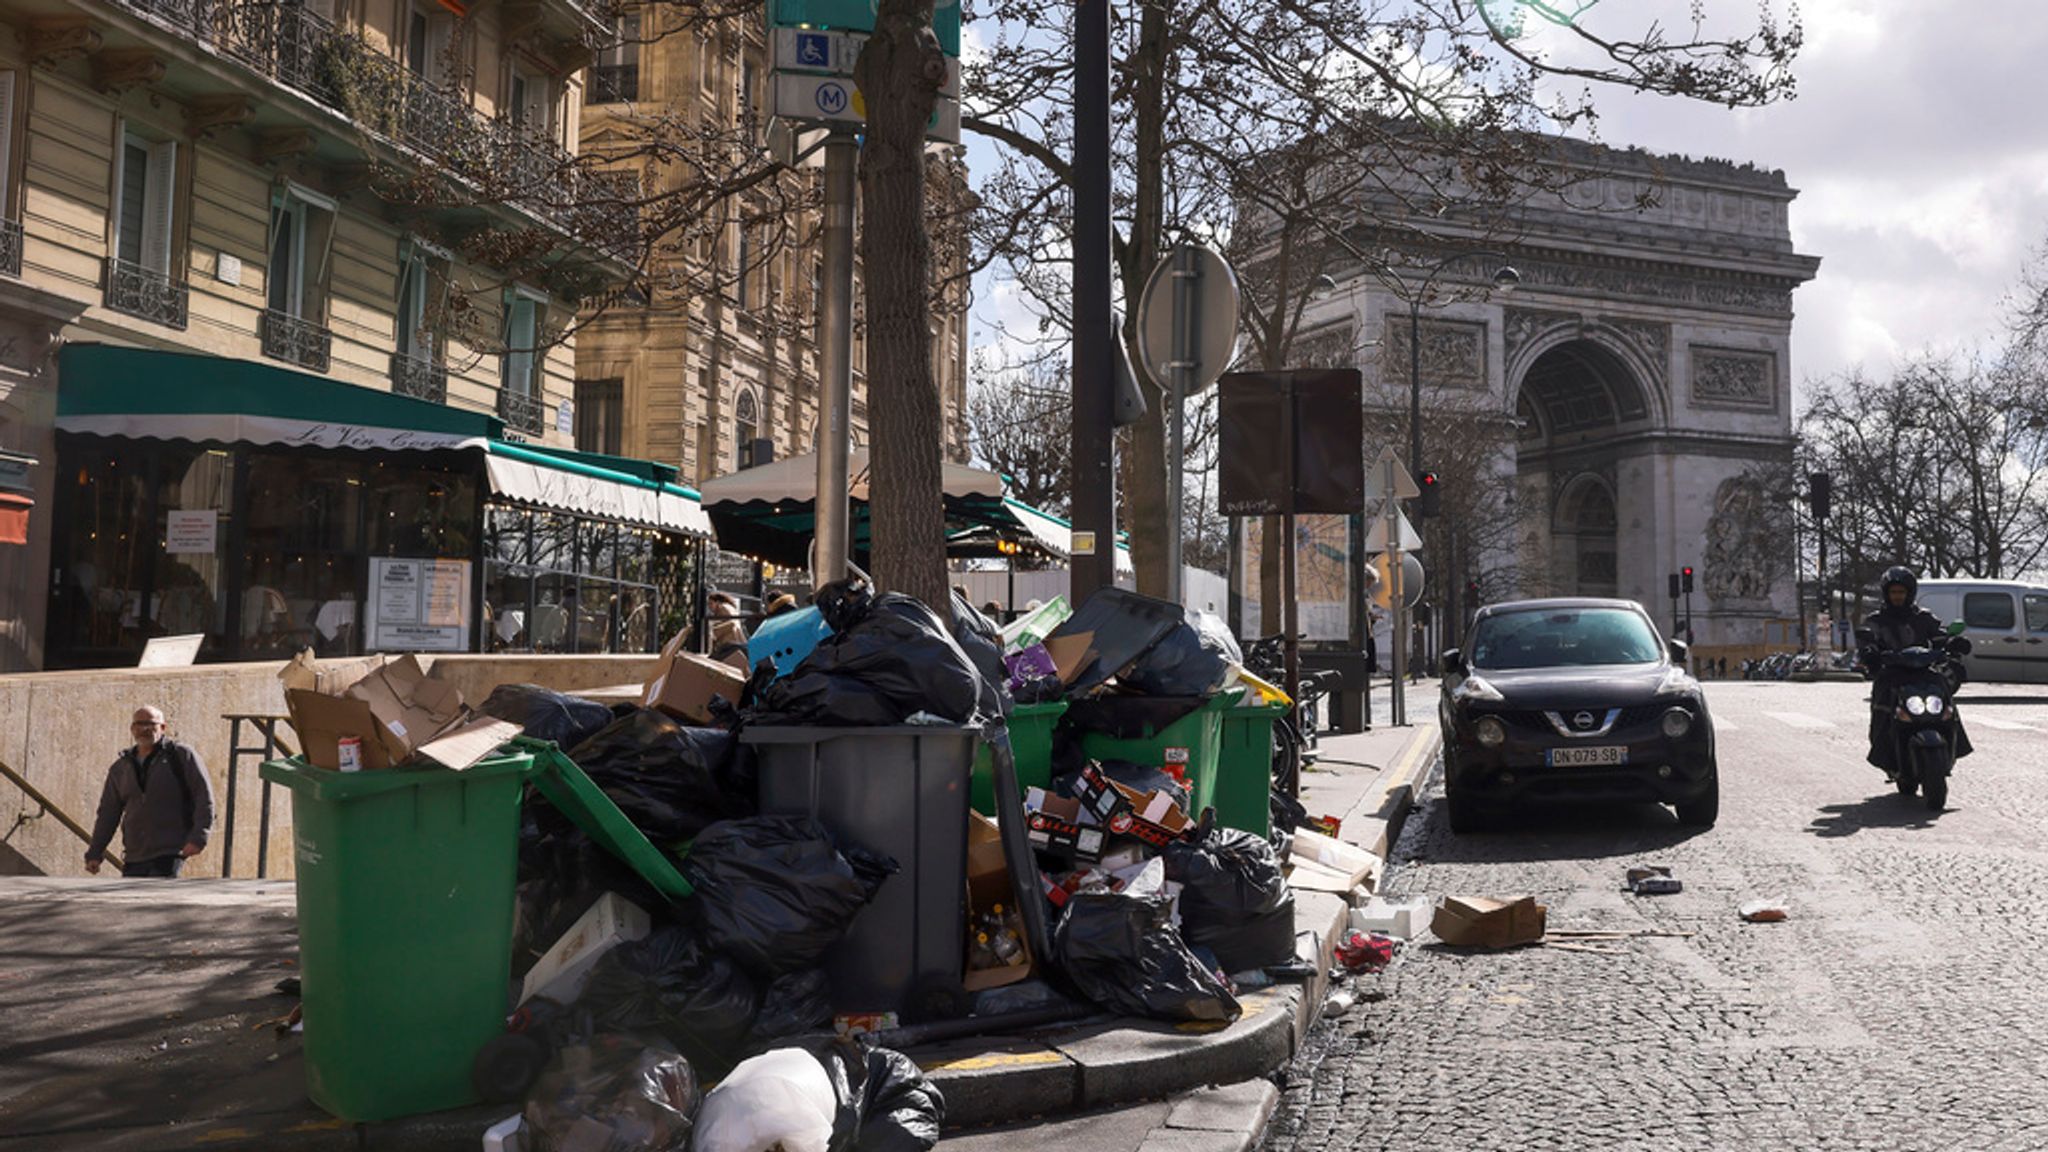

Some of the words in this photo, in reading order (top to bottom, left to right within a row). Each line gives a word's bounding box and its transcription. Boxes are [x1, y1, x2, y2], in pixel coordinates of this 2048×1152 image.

[823, 88, 840, 107] M
[285, 424, 327, 443] Le
[336, 425, 375, 446] Vin
